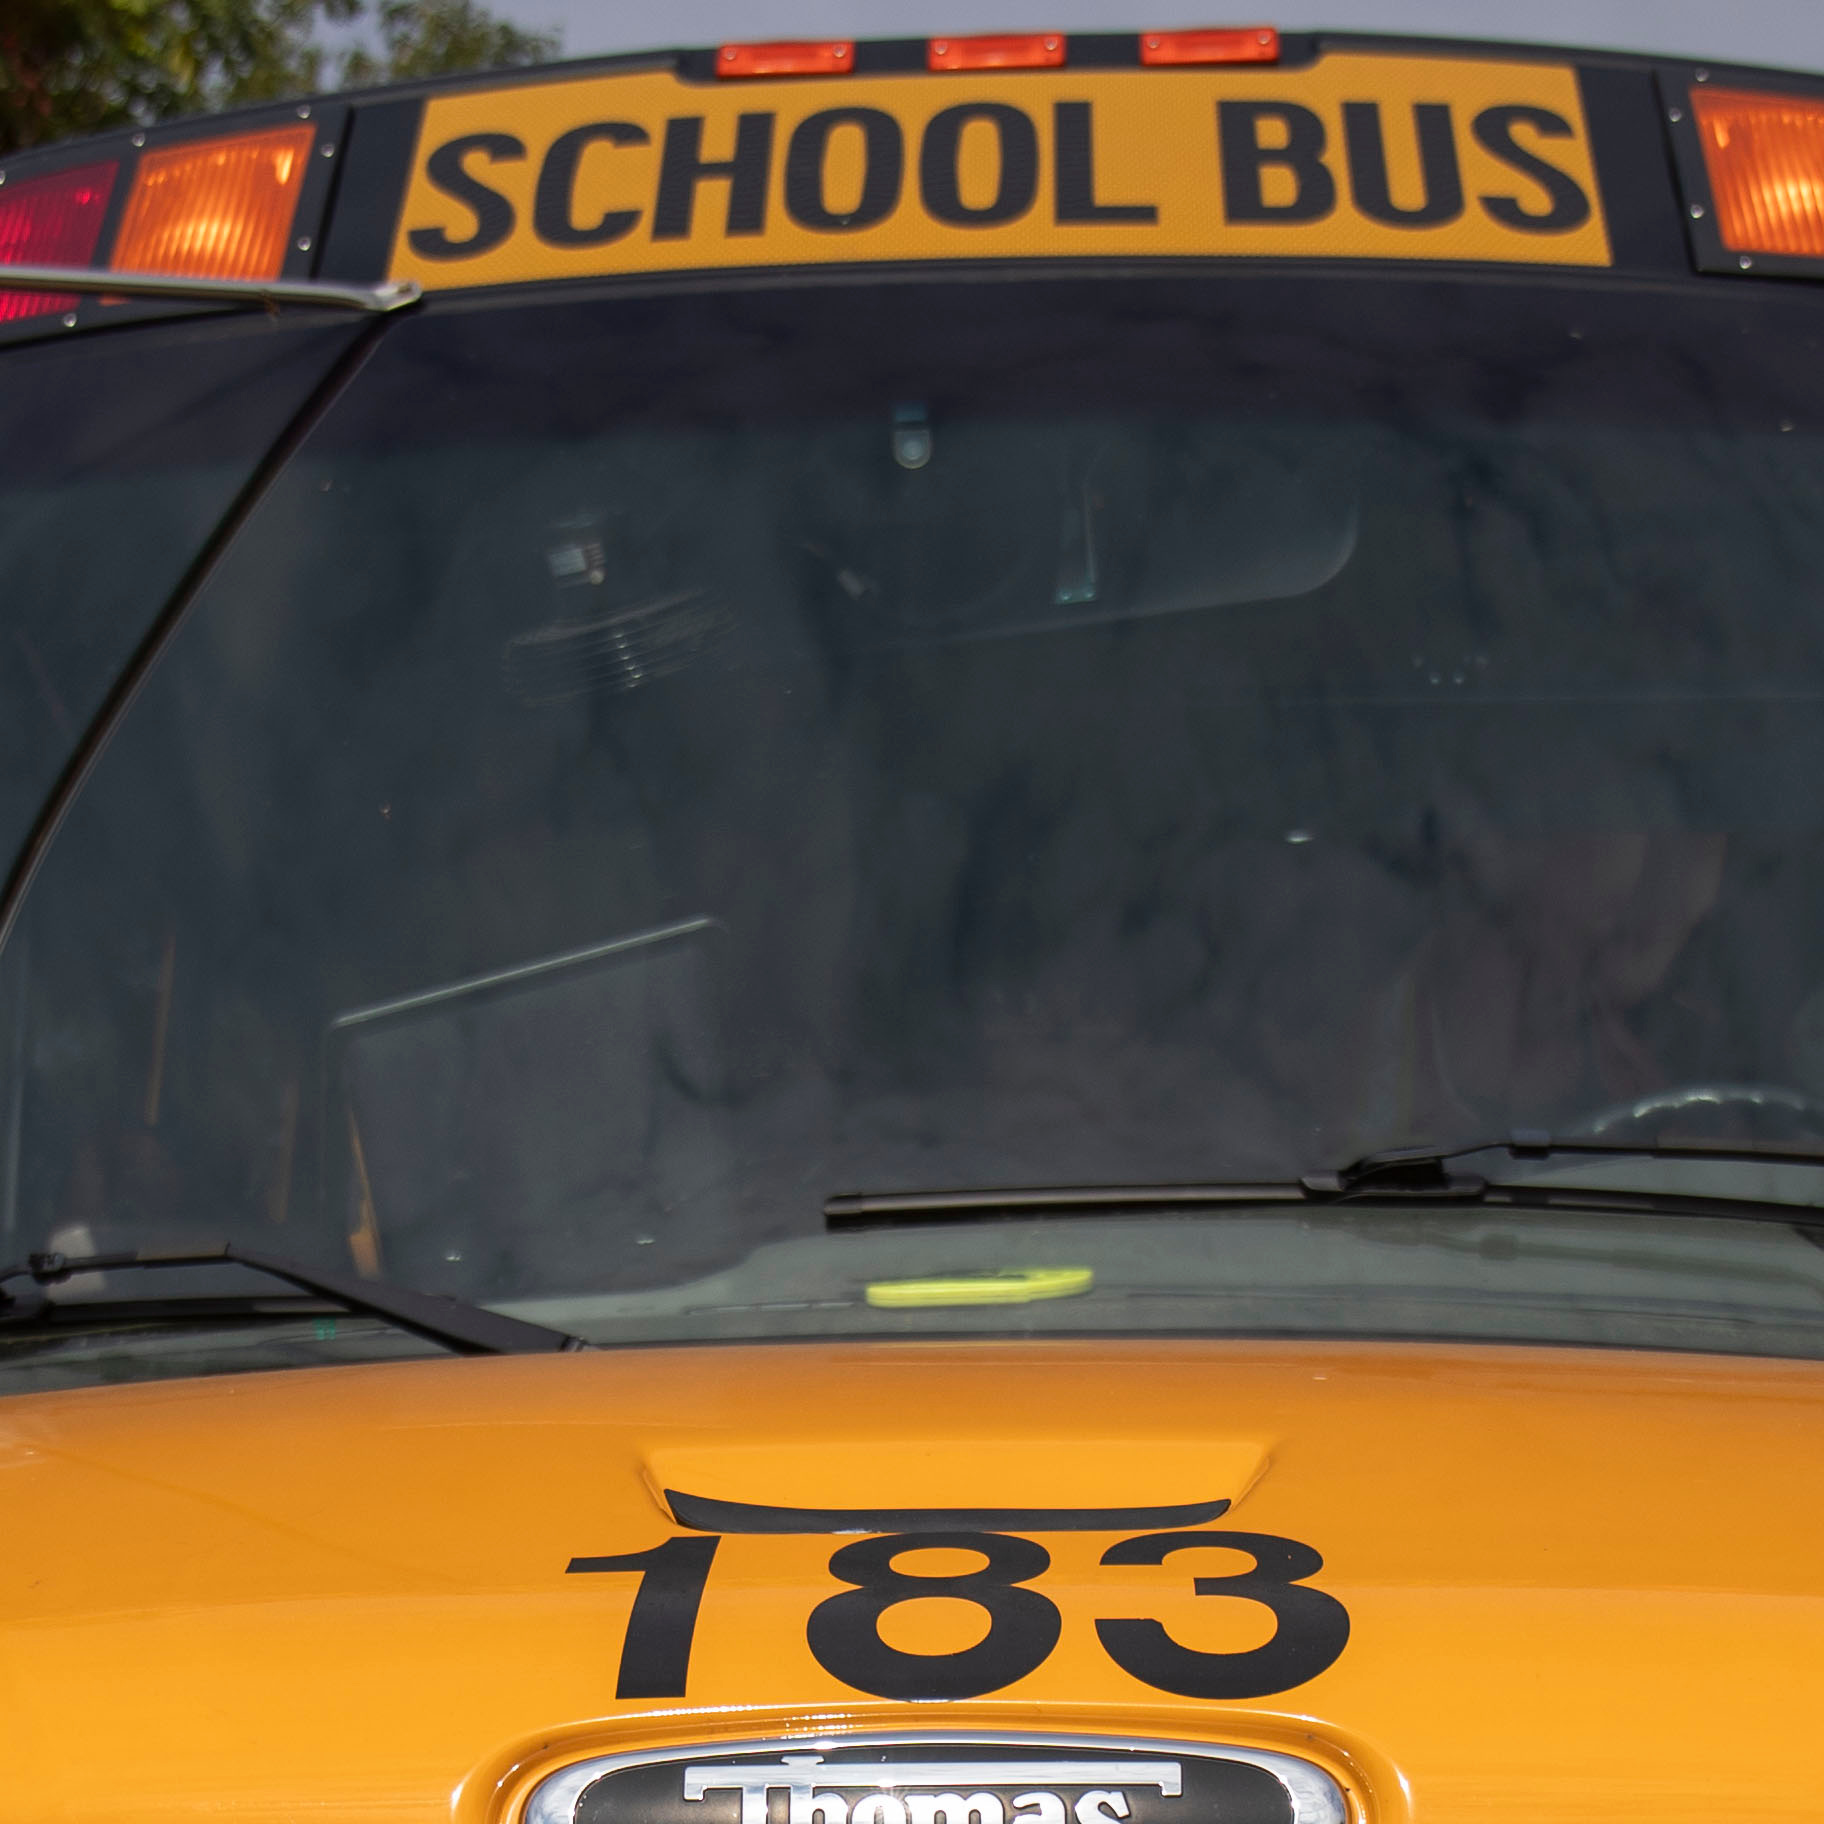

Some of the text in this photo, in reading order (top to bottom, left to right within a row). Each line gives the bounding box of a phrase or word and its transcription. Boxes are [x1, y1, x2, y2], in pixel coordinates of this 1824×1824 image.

[407, 99, 1592, 261] SCHOOL BUS
[564, 1530, 1351, 1702] 183
